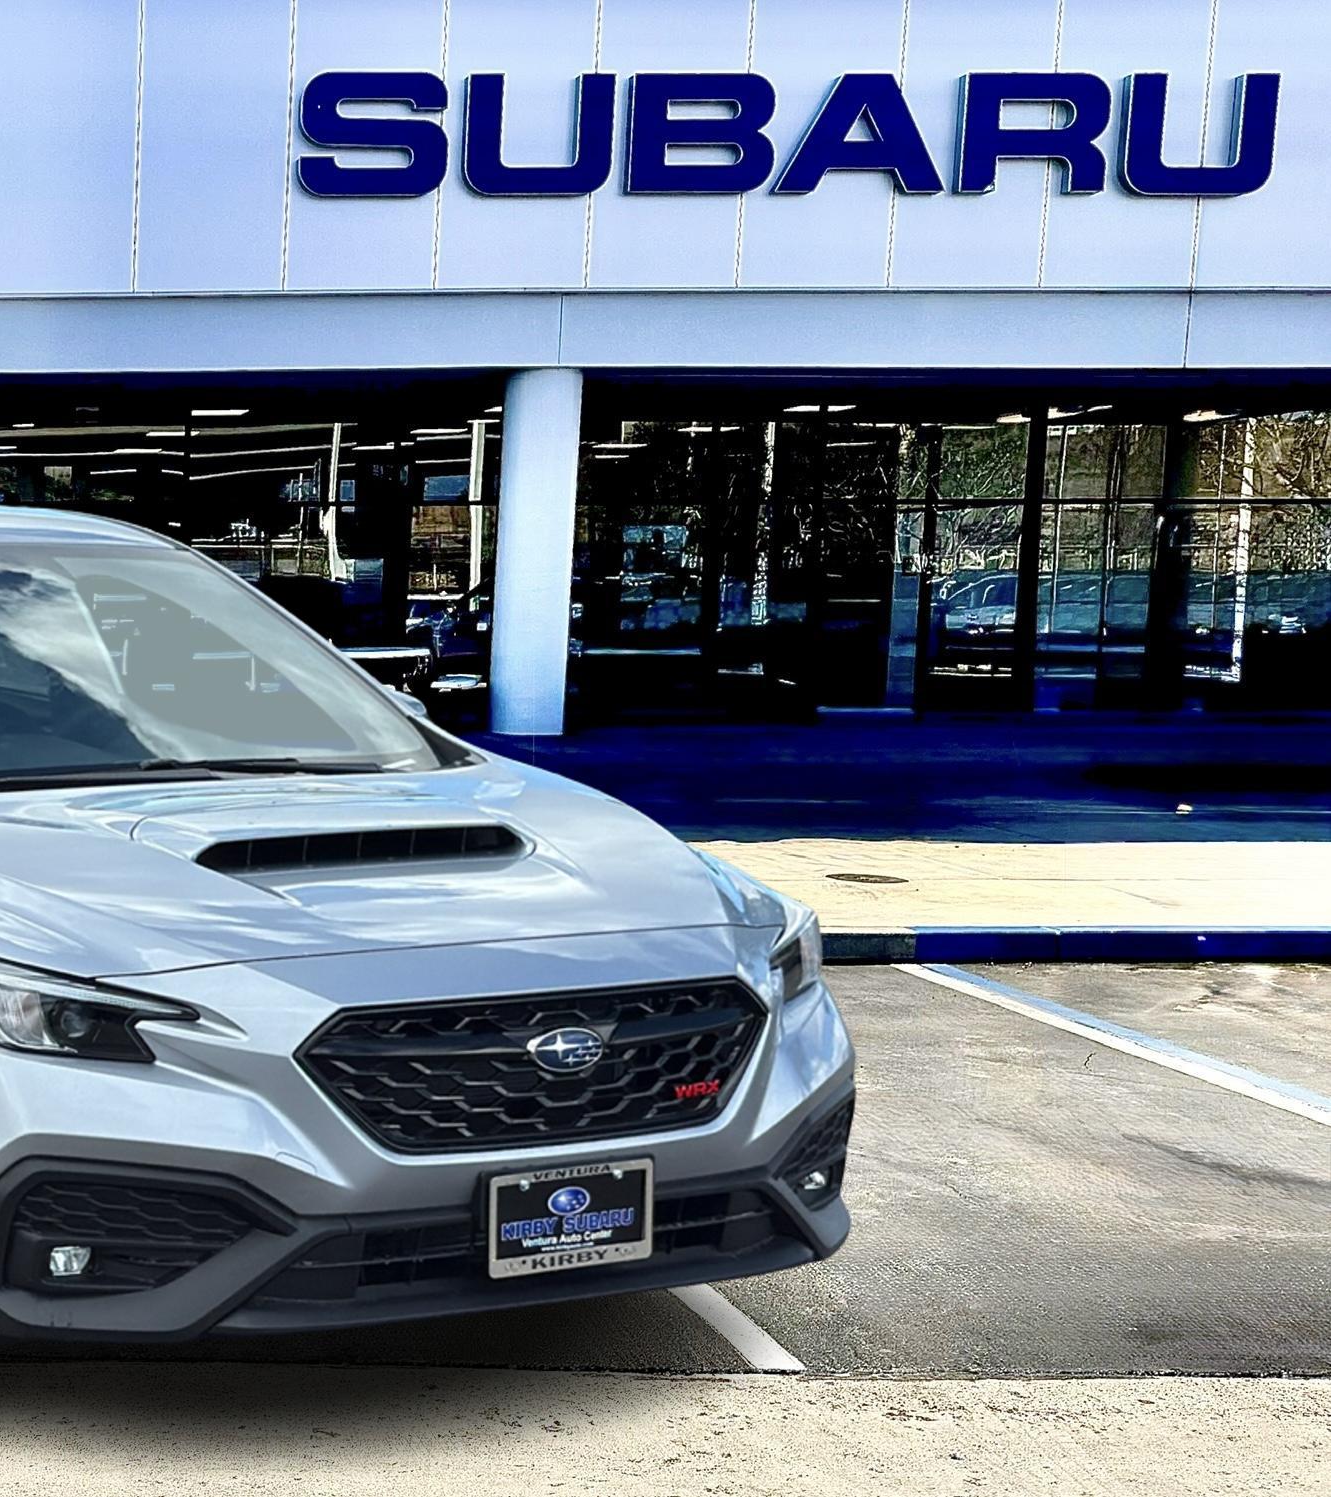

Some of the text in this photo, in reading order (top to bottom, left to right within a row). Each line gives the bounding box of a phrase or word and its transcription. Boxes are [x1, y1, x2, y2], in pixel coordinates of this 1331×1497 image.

[298, 72, 1281, 197] SUBARU
[674, 1079, 720, 1098] WRX
[533, 1165, 612, 1181] VENTURA
[501, 1207, 634, 1241] KIRBY SUBARU
[522, 1236, 557, 1248] Ventura
[559, 1233, 582, 1244] Auto
[583, 1229, 613, 1242] Center
[531, 1249, 608, 1269] KIRBY
